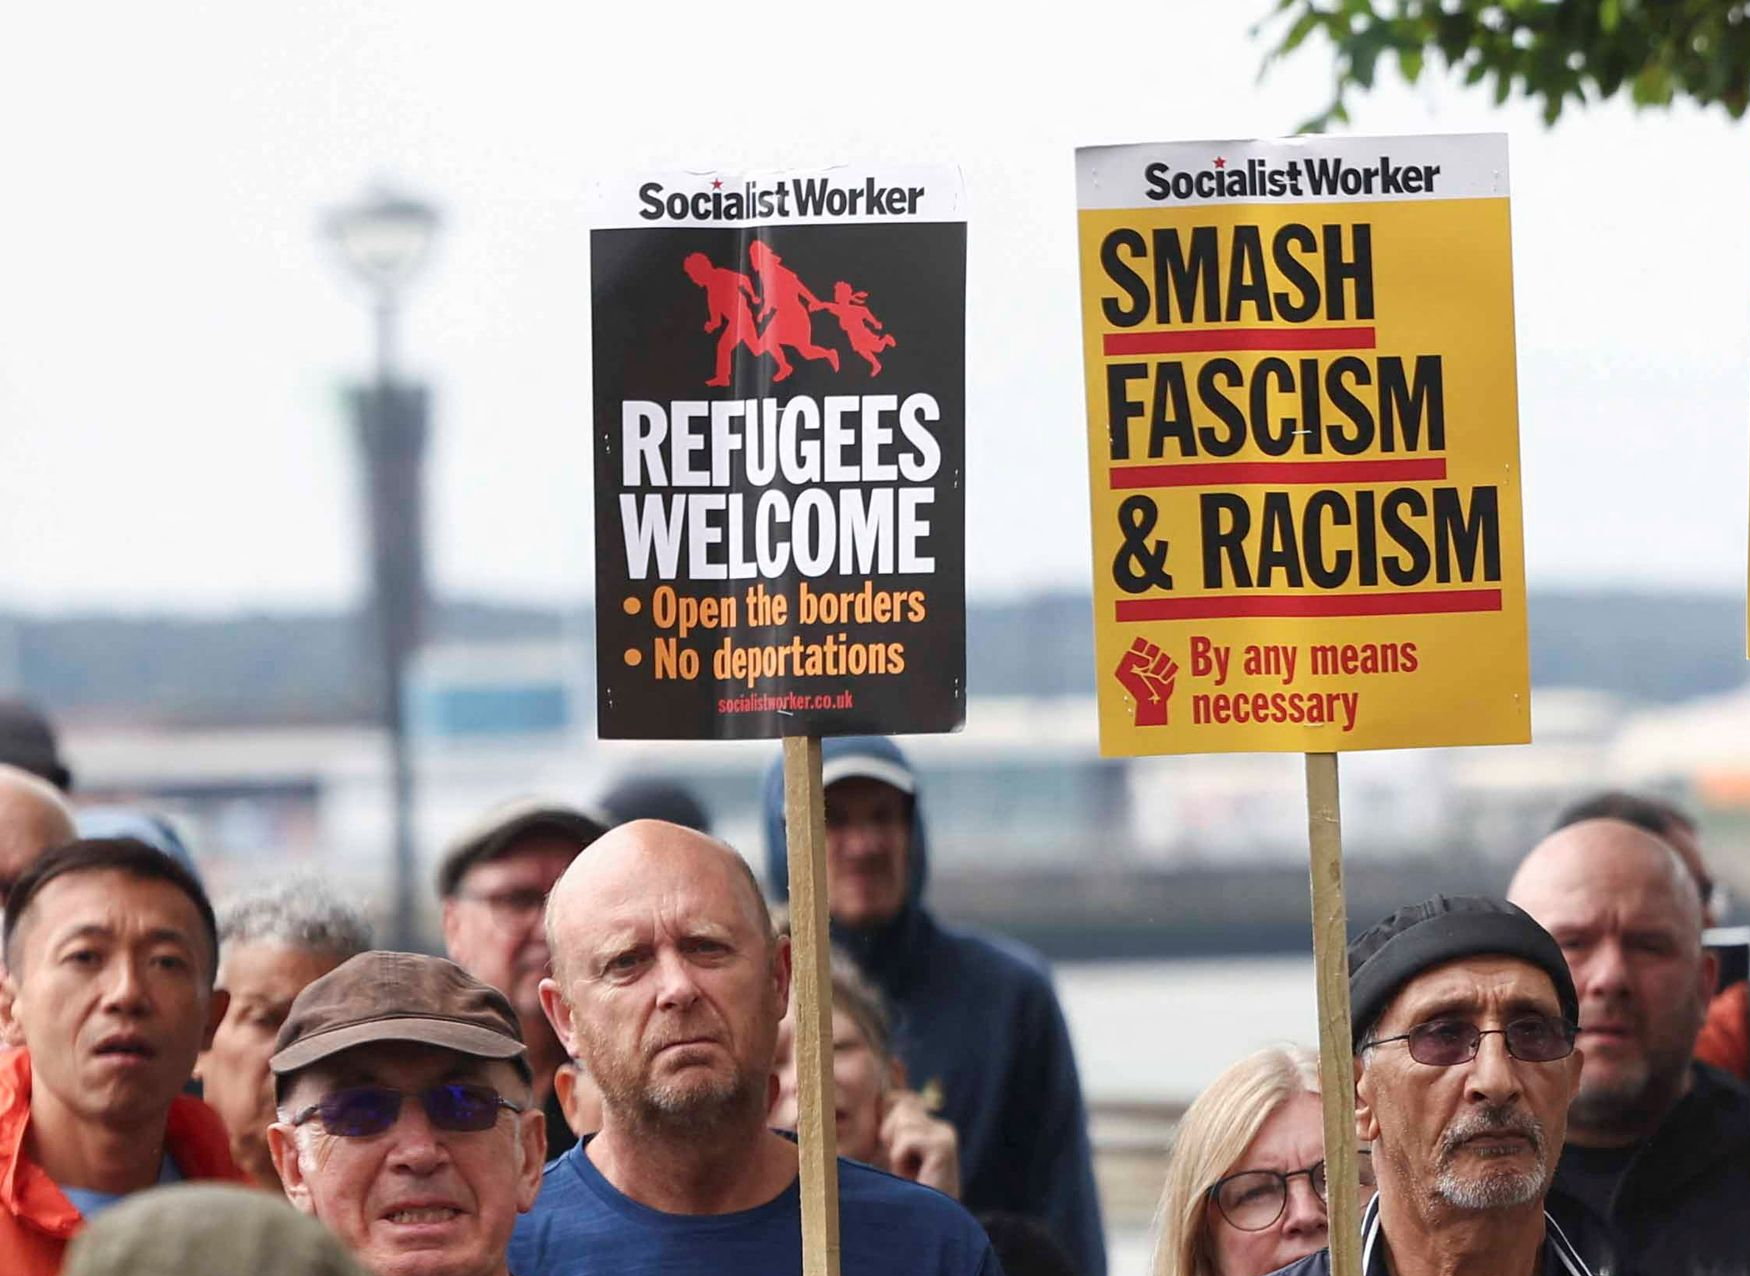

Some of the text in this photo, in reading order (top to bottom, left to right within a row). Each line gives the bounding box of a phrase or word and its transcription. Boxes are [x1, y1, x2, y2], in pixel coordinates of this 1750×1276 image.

[638, 178, 924, 220] Socialist Worker
[1145, 157, 1440, 200] Socialist Worker
[1101, 223, 1375, 327] SMASH
[1107, 355, 1445, 460] FASCISM
[622, 393, 941, 486] REFUGEES
[619, 487, 935, 579] WELCOME
[1113, 486, 1501, 593] & RACISM
[652, 581, 926, 638] Open the borders
[653, 633, 906, 688] No deportations
[1190, 637, 1418, 685] By any means
[718, 690, 854, 714] socialistworker.co.uk
[1193, 692, 1358, 731] necessary
